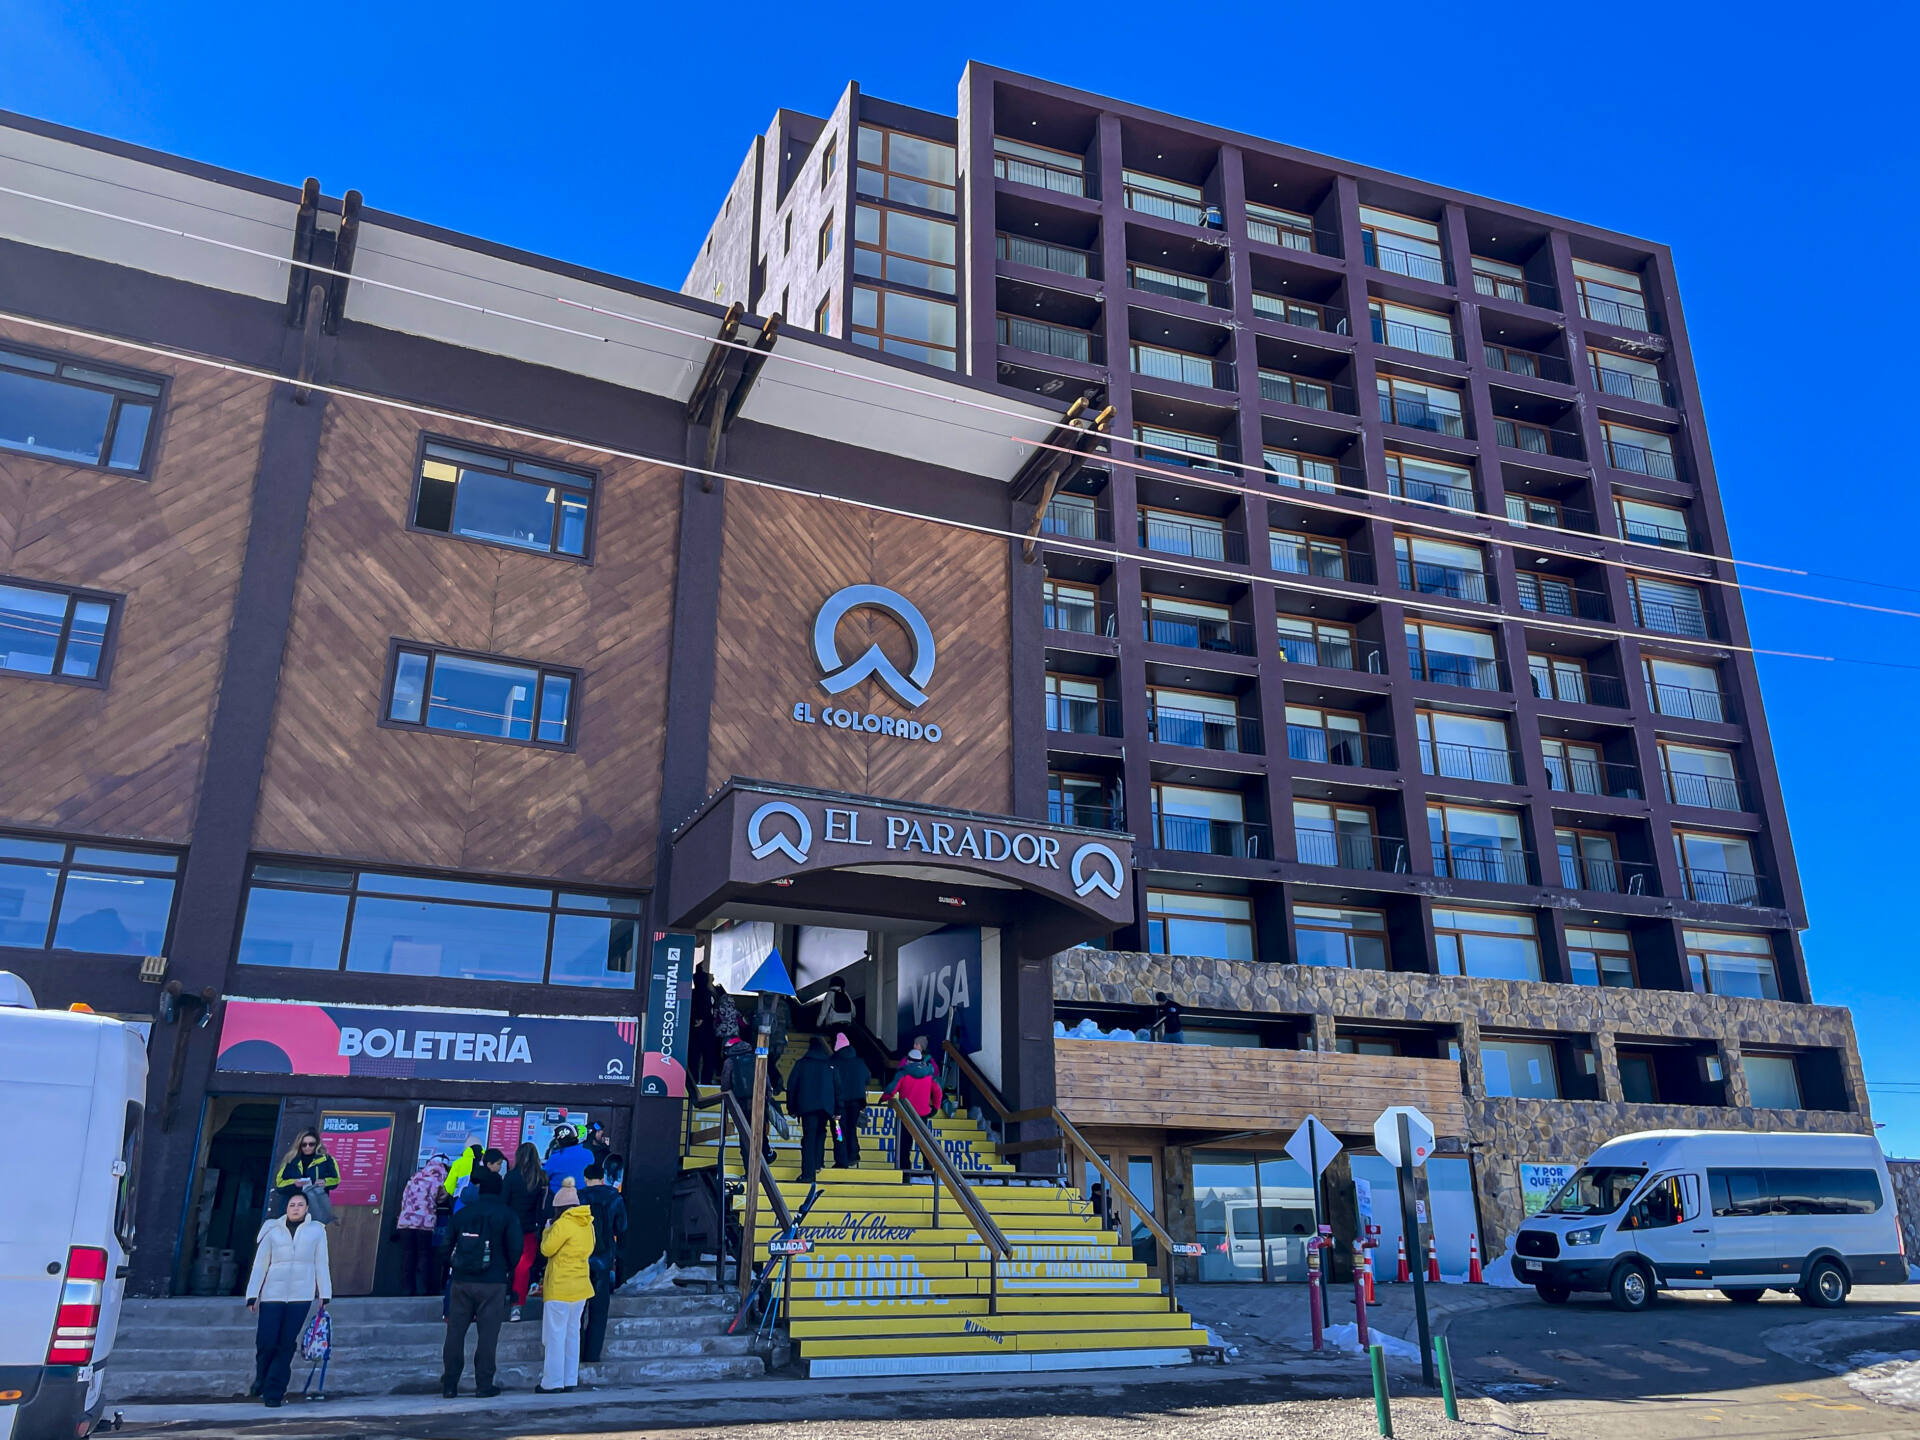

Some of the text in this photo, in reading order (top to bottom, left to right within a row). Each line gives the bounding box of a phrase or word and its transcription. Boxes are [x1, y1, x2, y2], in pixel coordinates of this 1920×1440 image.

[793, 702, 943, 743] EL COLORADO
[824, 808, 1060, 870] EL PARADOR
[665, 963, 679, 1009] RENTAL
[910, 959, 970, 1027] VISA
[338, 1026, 533, 1064] BOLETERÍA
[661, 1011, 675, 1066] ACCESO
[323, 1123, 359, 1131] PRECIOS
[1530, 1174, 1551, 1188] QUÉ
[1533, 1167, 1564, 1177] Y POR
[770, 1242, 804, 1251] BAJADA
[1172, 1244, 1198, 1254] SUBIDA
